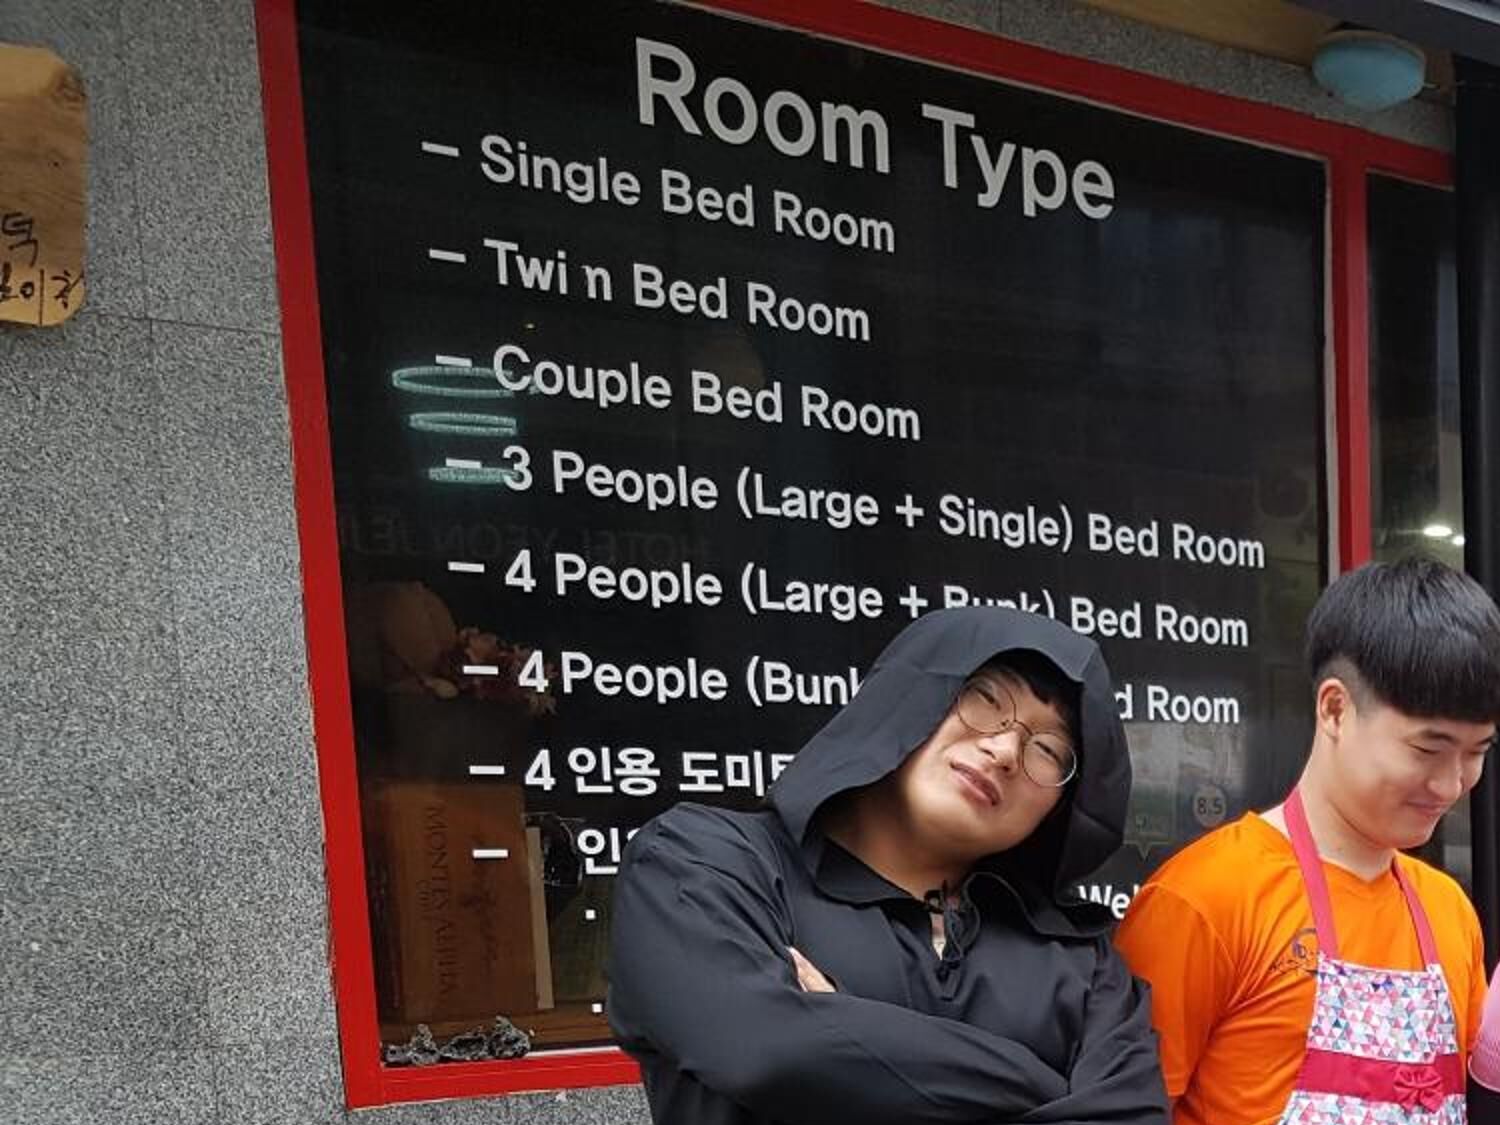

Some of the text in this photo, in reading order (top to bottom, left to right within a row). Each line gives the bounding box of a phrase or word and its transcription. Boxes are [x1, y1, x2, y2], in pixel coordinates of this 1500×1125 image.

[637, 39, 1114, 219] Room Type
[482, 136, 894, 252] Single Bed Room
[634, 264, 727, 318] Bed
[748, 282, 869, 341] Room
[494, 345, 919, 440] Couple Bed Room
[503, 446, 1264, 568] 3 People (Large + Single) Bed Room
[506, 550, 1247, 646] 4 People (Large + Bk) Bed Room
[519, 651, 548, 692] 4
[562, 652, 727, 703] People
[1148, 684, 1239, 732] Room
[525, 748, 556, 791] 4
[568, 747, 660, 796] 인용
